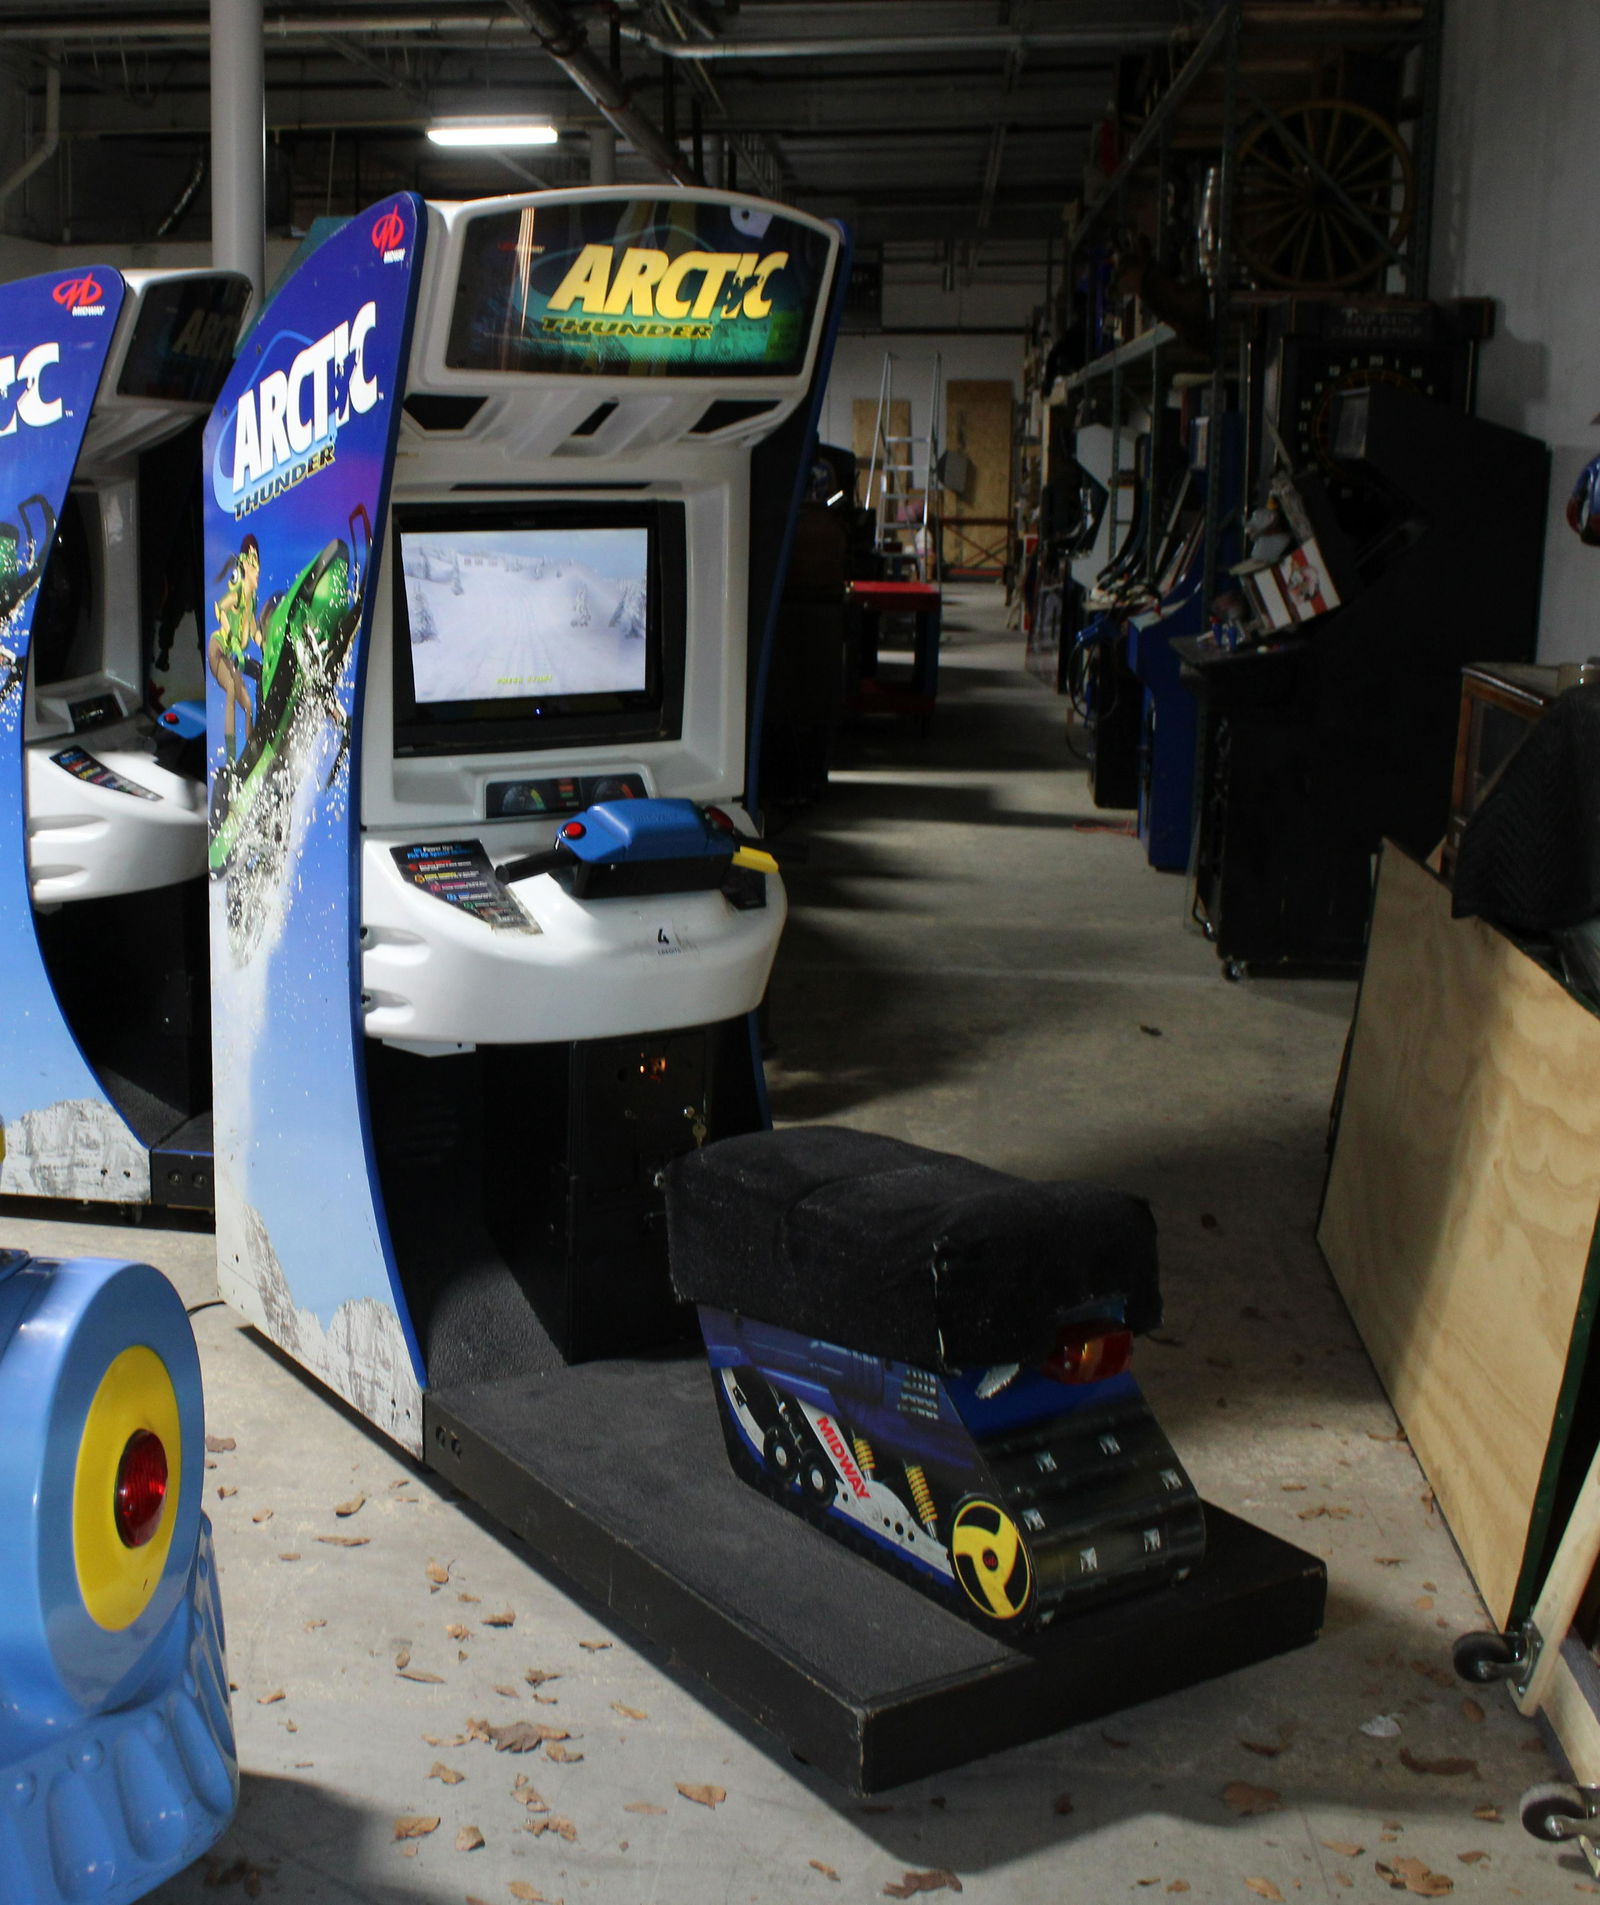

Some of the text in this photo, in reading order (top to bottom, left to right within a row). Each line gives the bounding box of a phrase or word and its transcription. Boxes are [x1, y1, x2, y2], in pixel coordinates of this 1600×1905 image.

[384, 248, 405, 264] MIDWAY
[546, 243, 789, 319] ARCTIC
[72, 305, 105, 317] MIDWAY
[541, 315, 714, 339] THUNDER
[232, 301, 377, 494] ARCTIC
[233, 442, 337, 522] THUNDER
[657, 928, 670, 945] 4
[816, 1415, 872, 1499] MIDWAY
